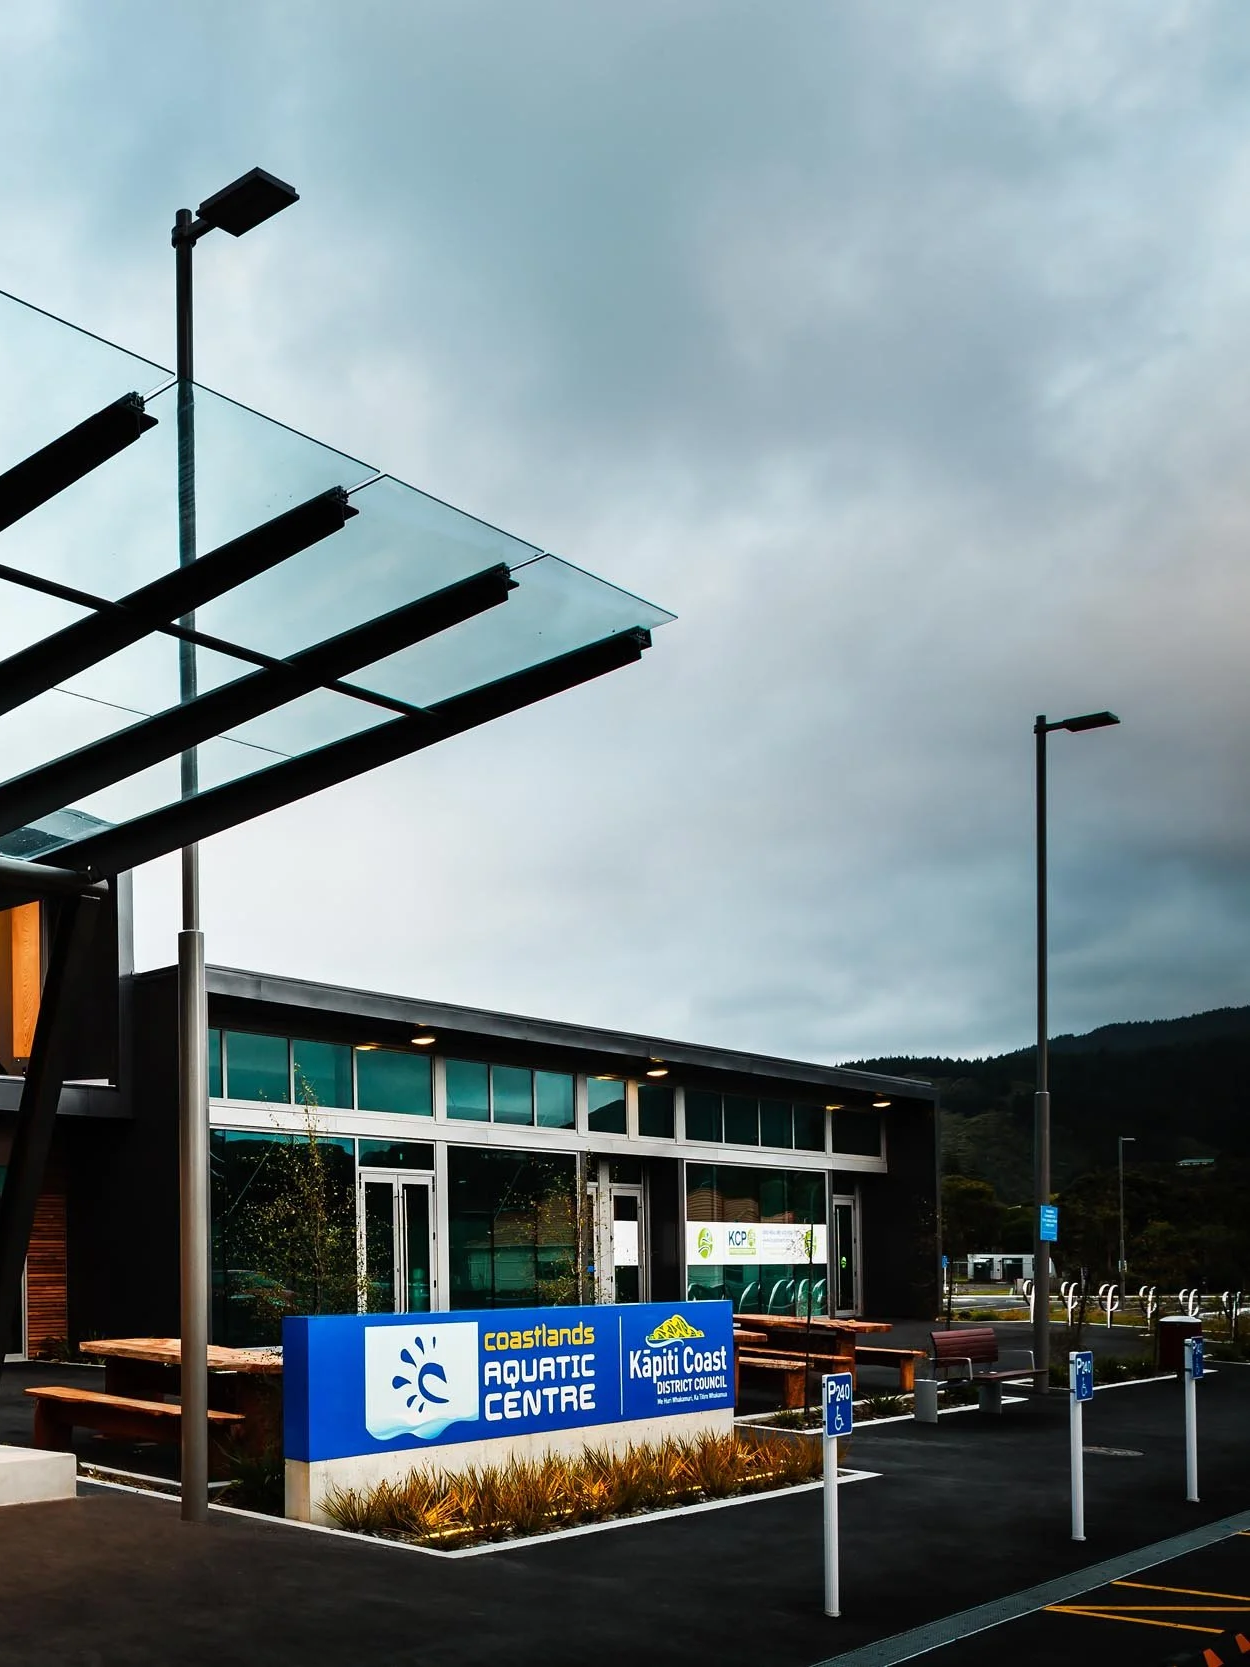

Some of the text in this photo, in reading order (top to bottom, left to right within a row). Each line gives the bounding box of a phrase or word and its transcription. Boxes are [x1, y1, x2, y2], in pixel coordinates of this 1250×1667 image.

[728, 1230, 747, 1246] KCP
[484, 1321, 595, 1351] coastlands
[484, 1354, 595, 1389] AQUATIC
[630, 1346, 727, 1383] Kāpiti Coast
[657, 1375, 727, 1395] DISTRICT COUNCIL
[828, 1381, 850, 1403] P240
[484, 1383, 595, 1421] CENTRE
